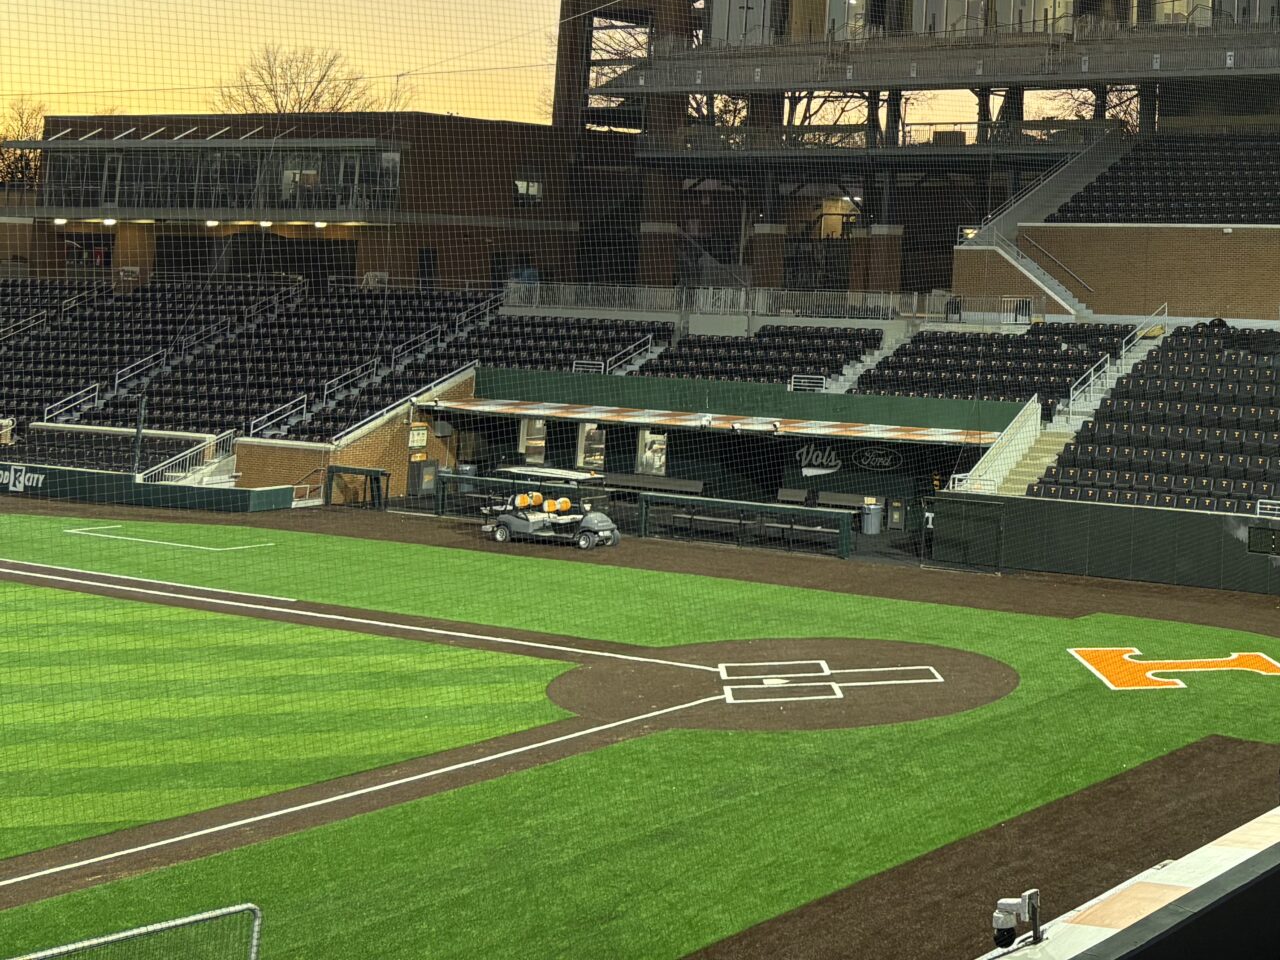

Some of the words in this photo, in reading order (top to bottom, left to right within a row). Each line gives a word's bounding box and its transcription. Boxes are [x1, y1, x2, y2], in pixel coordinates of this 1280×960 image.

[796, 444, 841, 467] Vols
[861, 450, 893, 466] Ford
[25, 473, 46, 487] CITY
